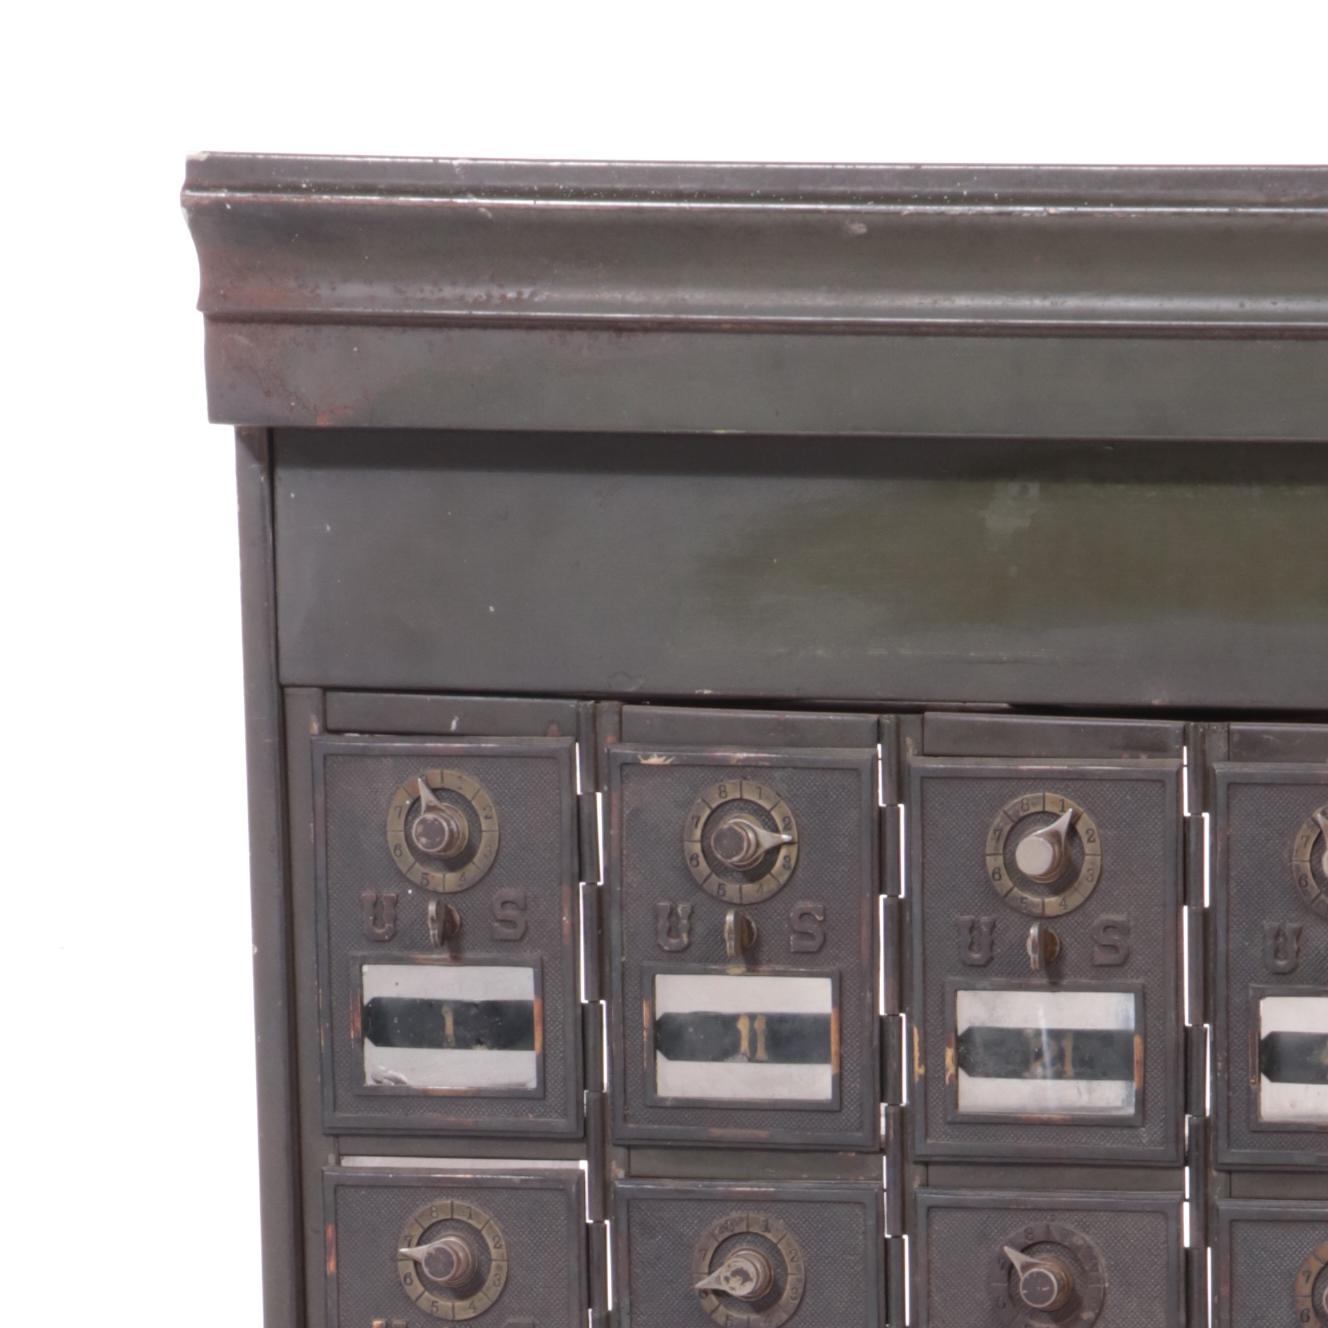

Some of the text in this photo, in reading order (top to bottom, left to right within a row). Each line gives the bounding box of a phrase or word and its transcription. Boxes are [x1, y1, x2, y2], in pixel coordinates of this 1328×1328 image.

[361, 887, 527, 941] U S
[655, 900, 826, 954] U S
[954, 913, 1131, 968] U S
[1264, 921, 1303, 974] U
[441, 1004, 455, 1048] 1
[736, 1015, 768, 1061] 11
